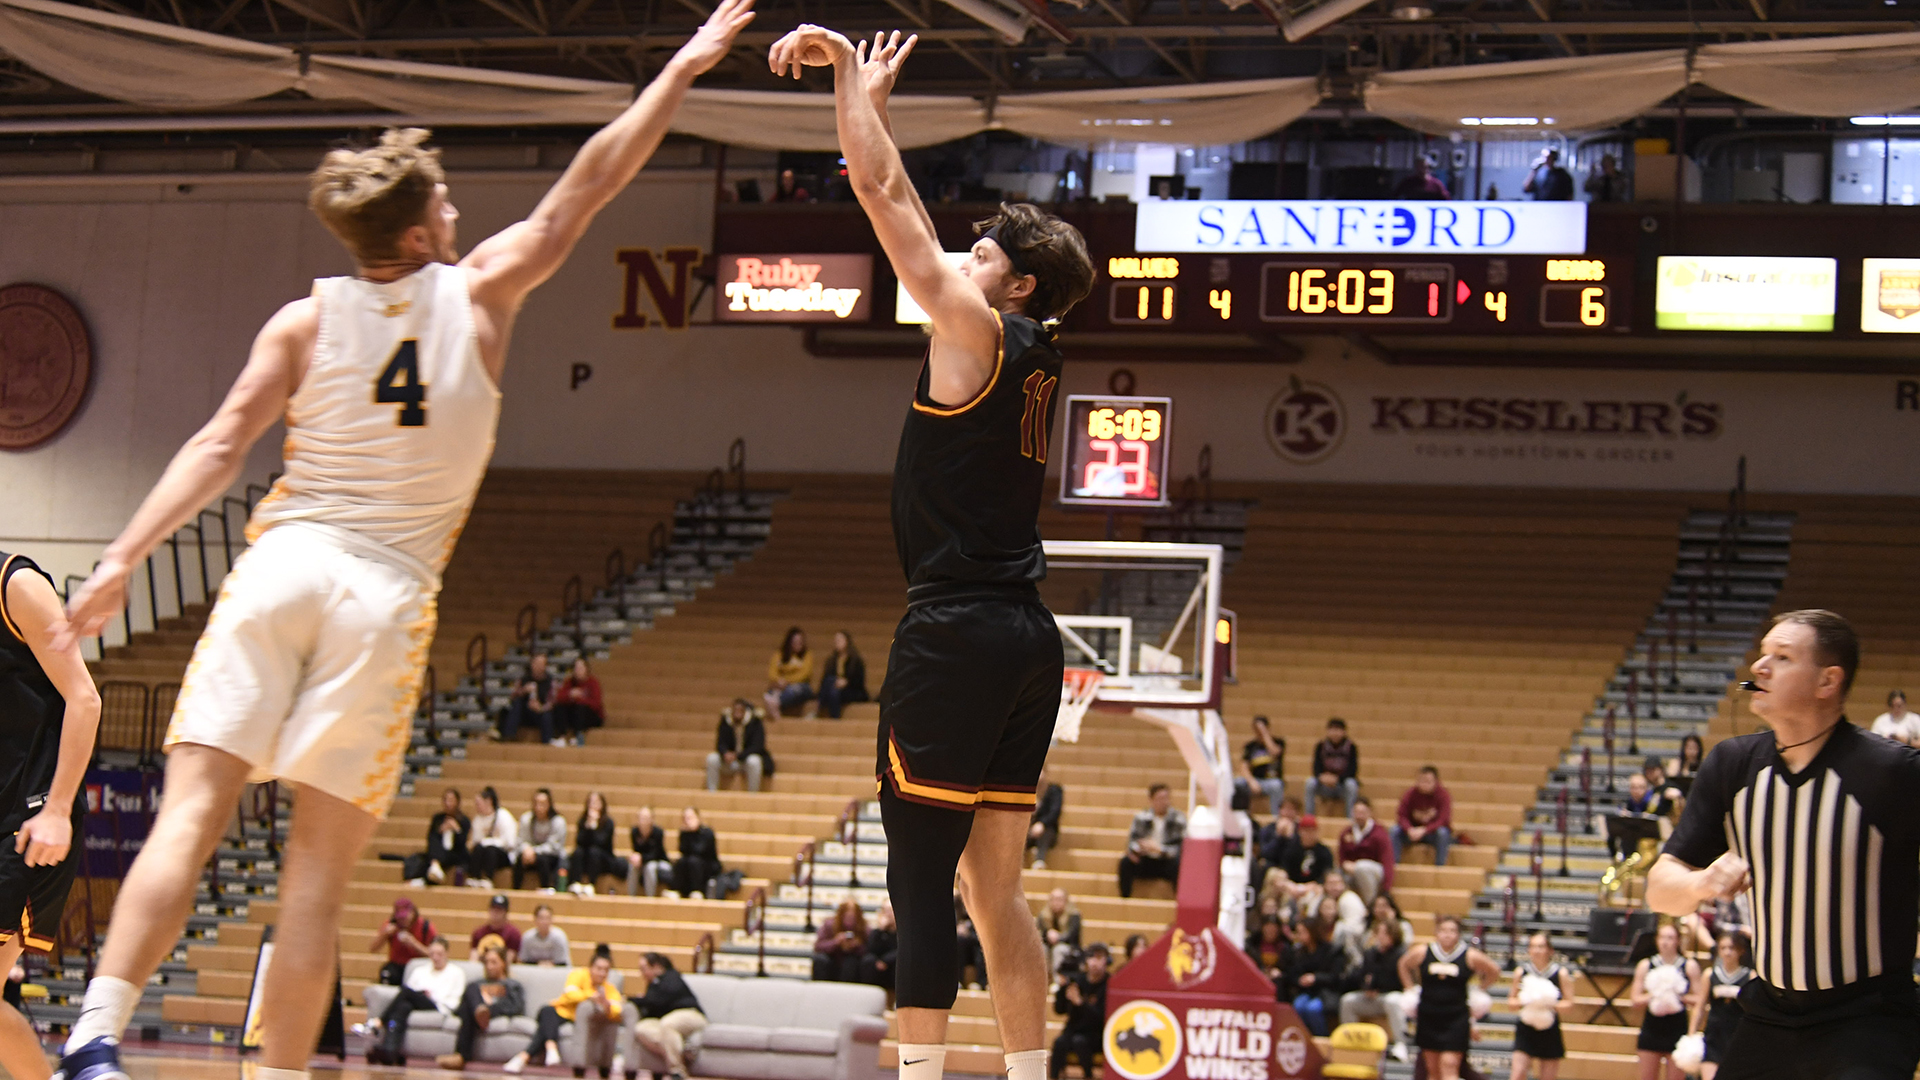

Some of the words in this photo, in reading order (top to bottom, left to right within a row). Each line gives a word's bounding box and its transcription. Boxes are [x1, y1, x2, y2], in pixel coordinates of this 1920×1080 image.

[1197, 205, 1517, 248] SANFORD
[735, 257, 822, 291] Ruby
[1109, 257, 1179, 278] WOLVES
[612, 247, 702, 330] N
[725, 282, 862, 318] Tuesday
[1138, 286, 1174, 320] 11
[1209, 289, 1232, 320] 4
[1287, 269, 1394, 315] 16:03
[1428, 282, 1439, 317] 1
[1484, 291, 1507, 322] 4
[1580, 287, 1606, 326] 6
[370, 337, 430, 428] 4
[570, 363, 592, 390] P
[1897, 380, 1920, 410] R
[1020, 368, 1057, 464] 11
[1088, 408, 1161, 441] 16:03
[1370, 389, 1722, 438] KESSLER'S
[1084, 439, 1149, 495] 23
[1414, 443, 1465, 458] YOUR
[1593, 447, 1675, 462] GROCER
[1186, 1008, 1272, 1031] BUFFALO
[1186, 1027, 1271, 1060] WILD
[1185, 1055, 1269, 1080] WINGS
